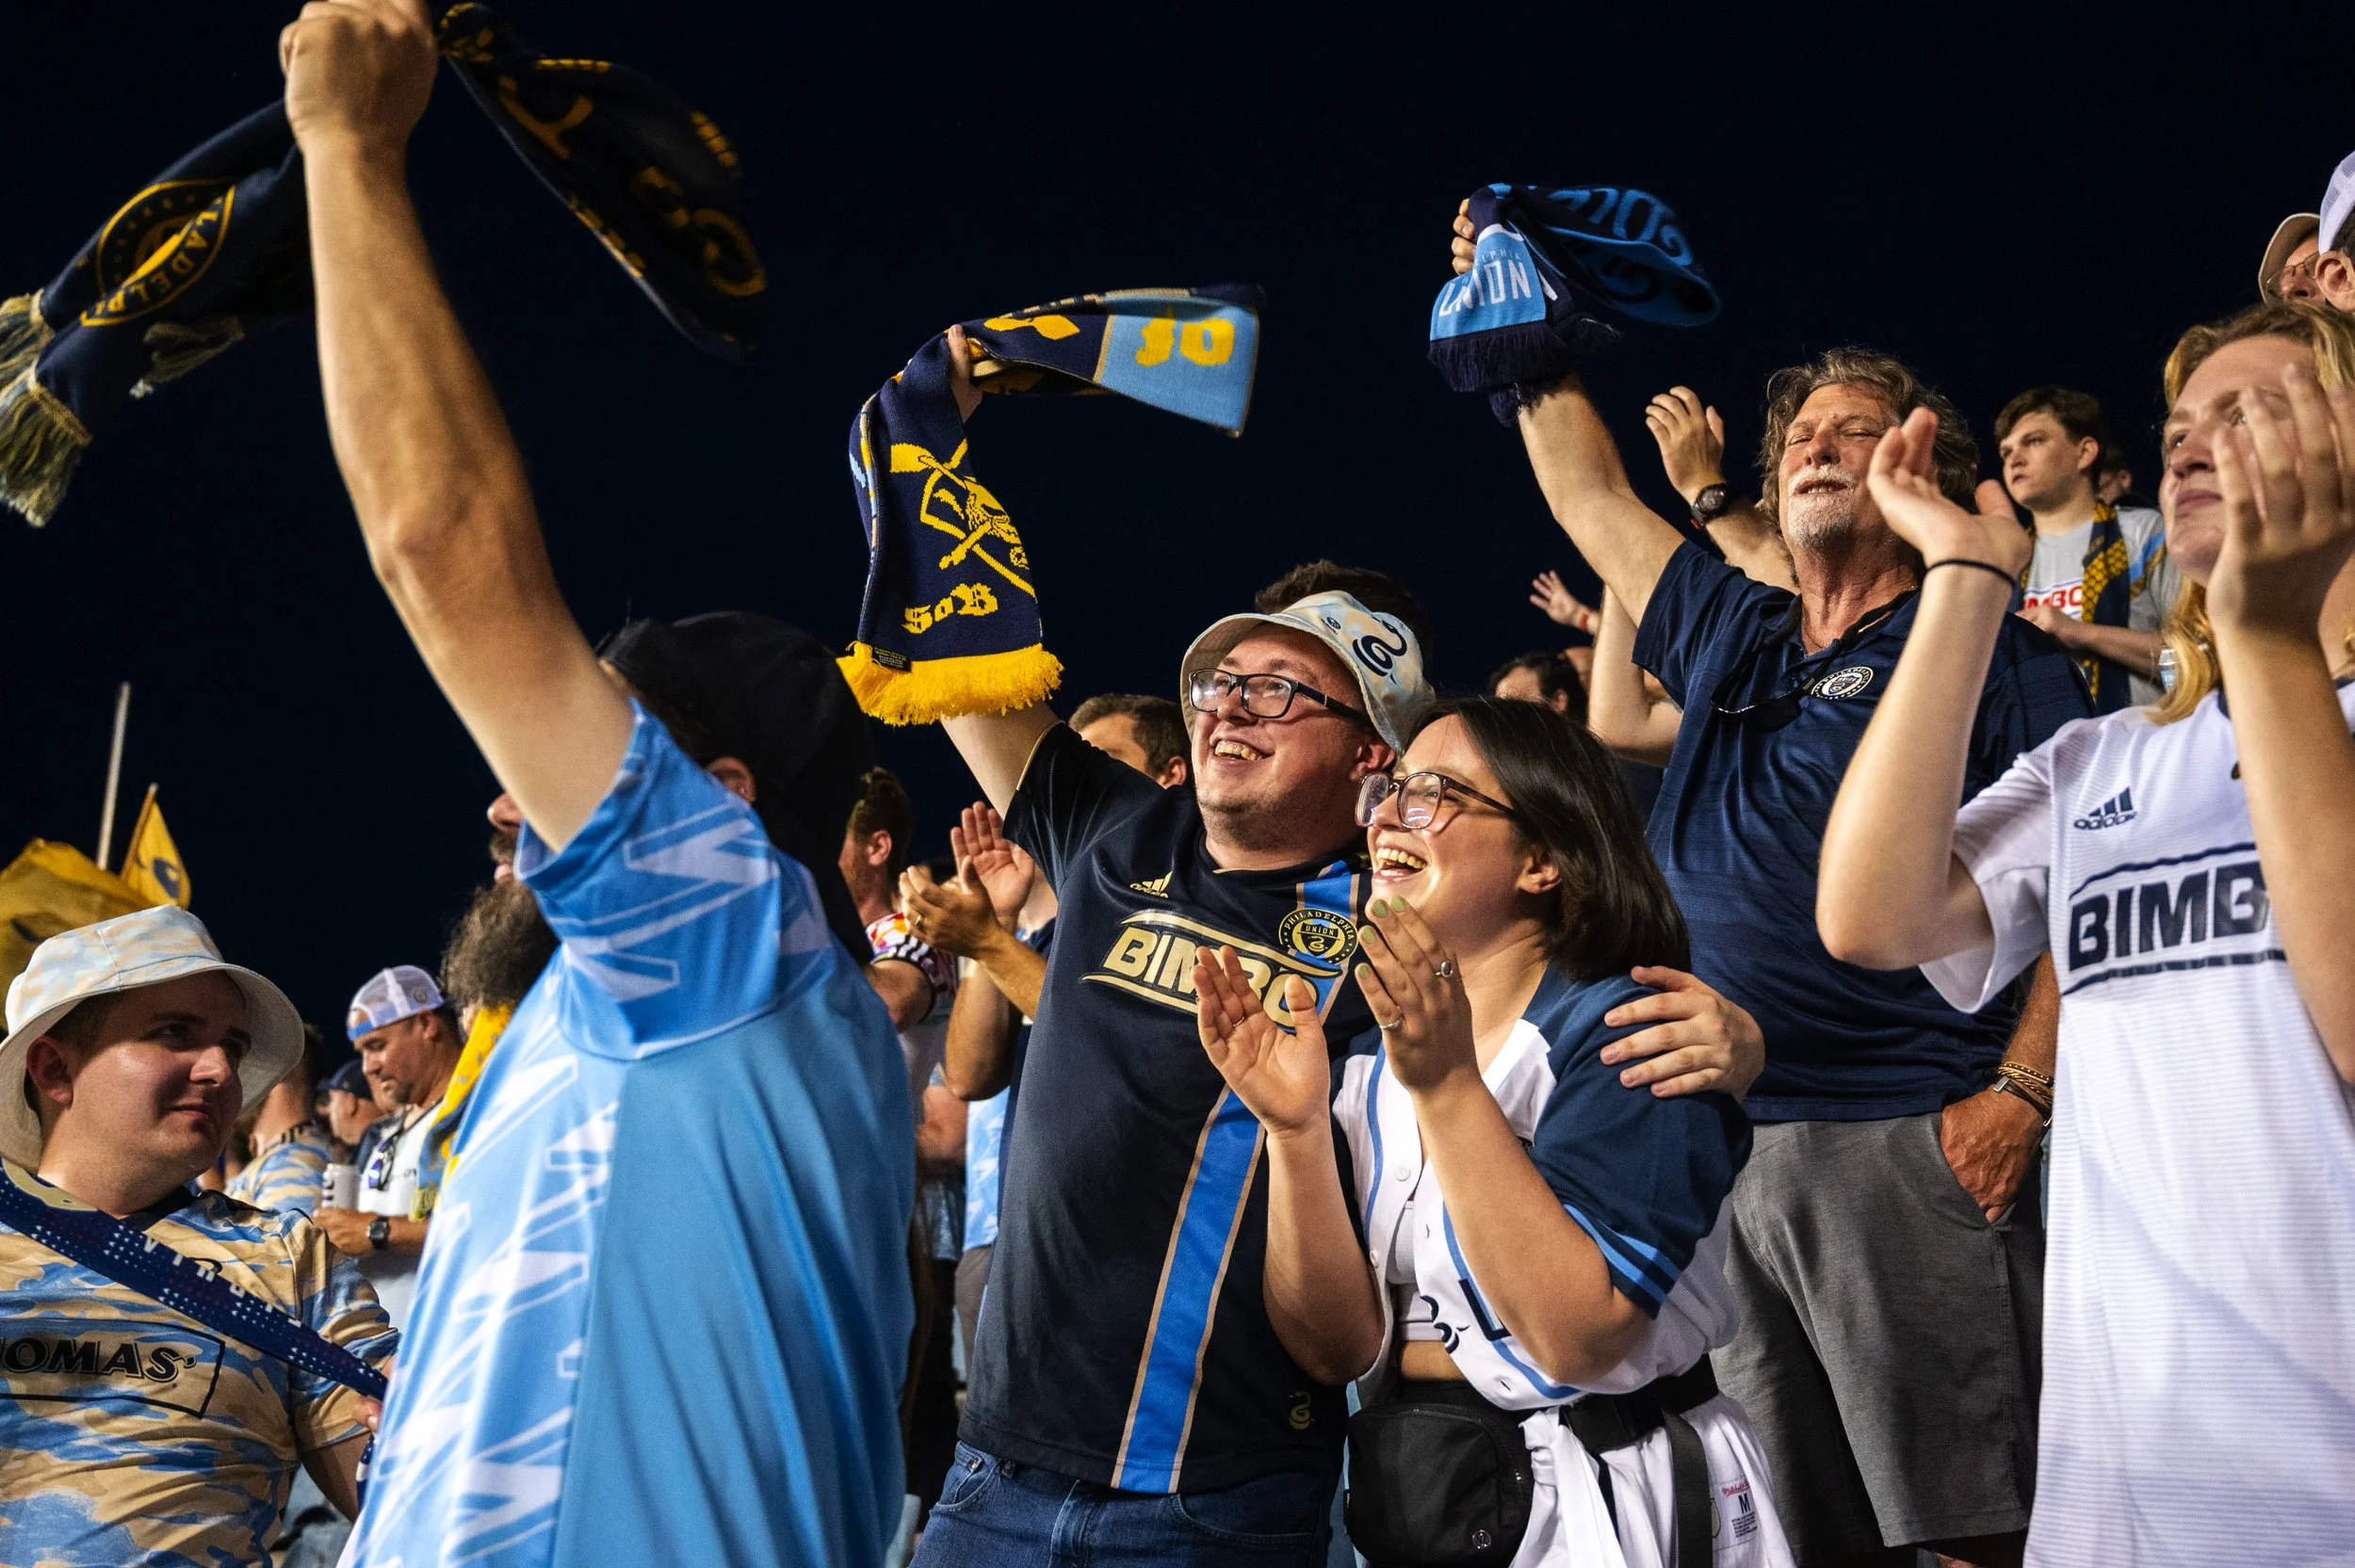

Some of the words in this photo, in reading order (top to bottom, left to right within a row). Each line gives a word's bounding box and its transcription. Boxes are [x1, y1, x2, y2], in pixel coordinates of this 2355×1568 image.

[1283, 911, 1355, 940] PHILADELPHIA
[1305, 925, 1335, 936] UNION
[0, 1335, 197, 1383] OMAS'
[1737, 1493, 1751, 1514] M
